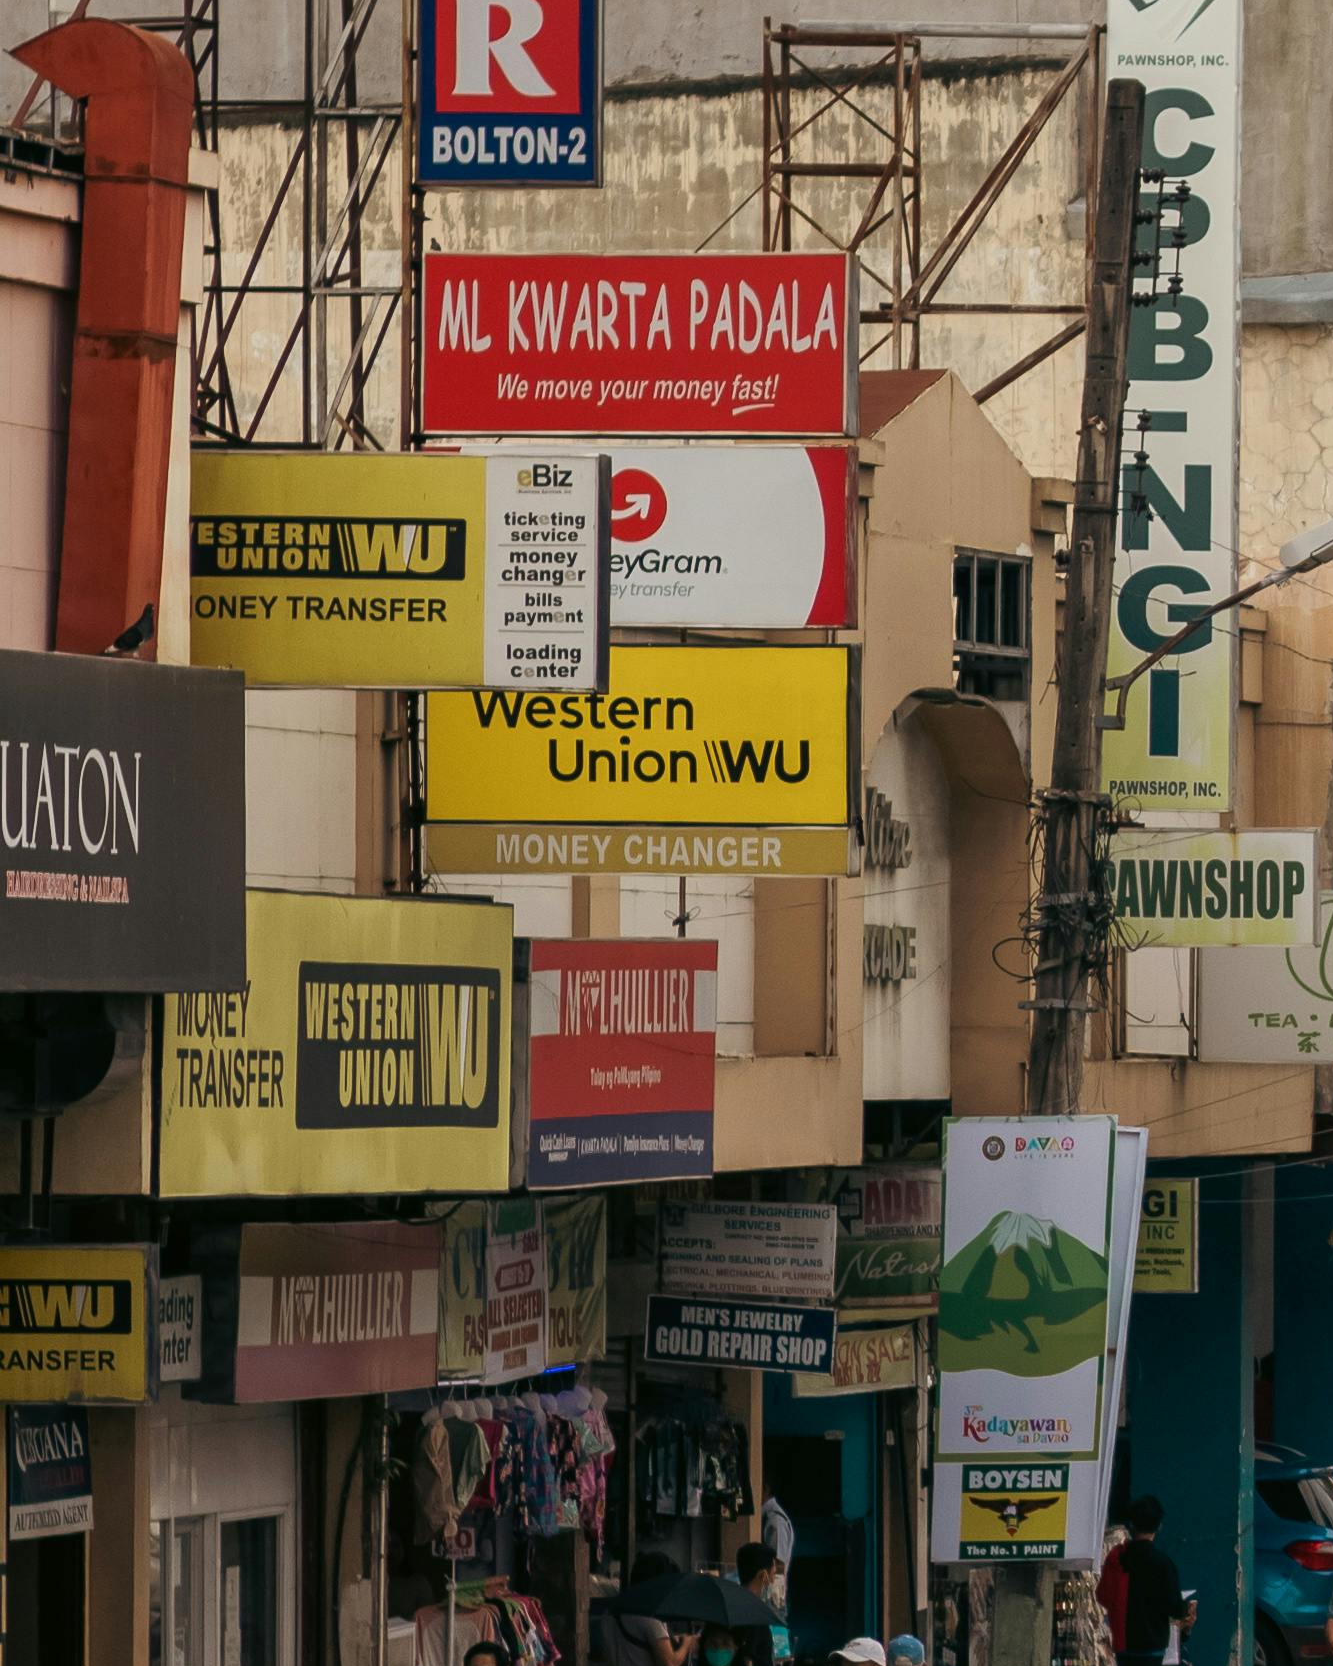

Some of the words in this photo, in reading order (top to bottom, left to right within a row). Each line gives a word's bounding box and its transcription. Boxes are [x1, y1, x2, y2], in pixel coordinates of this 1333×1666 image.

[1117, 55, 1196, 68] PAWNSHOP,
[1201, 55, 1229, 66] INC.
[432, 126, 587, 165] BOLTON-2
[438, 279, 491, 352] ML
[508, 279, 671, 354] KWARTA
[689, 278, 838, 354] PADALA
[497, 374, 528, 400] We
[535, 380, 592, 400] move
[597, 379, 649, 405] your
[652, 379, 726, 406] money
[731, 374, 780, 401] fast!
[517, 464, 573, 488] eBiz
[191, 522, 331, 546] ESTERN
[504, 511, 586, 530] ticketing
[351, 524, 447, 573] WU
[510, 529, 578, 543] service
[216, 548, 331, 572] UNION
[509, 551, 577, 567] money
[609, 549, 722, 578] eyGram
[501, 566, 586, 586] changer
[524, 593, 563, 607] bills
[630, 583, 695, 598] transfer
[192, 595, 277, 619] ONEY
[286, 596, 447, 622] TRANSFER
[504, 609, 583, 626] payment
[506, 644, 582, 663] loading
[510, 663, 578, 678] center
[472, 692, 693, 731] Western
[549, 736, 698, 782] Union
[1109, 780, 1189, 798] PAWNSHOP,
[1193, 782, 1221, 797] INC.
[496, 834, 608, 865] MONEY
[624, 834, 781, 867] CHANGER
[176, 981, 251, 1038] MONEY
[305, 982, 415, 1041] WESTERN
[600, 968, 689, 1035] LHUILLIER
[1248, 1013, 1298, 1028] TEA
[427, 984, 490, 1109] WU
[176, 1048, 284, 1109] TRANSFER
[339, 1049, 415, 1106] UNION
[1015, 1136, 1075, 1151] DAVAO
[1142, 1190, 1178, 1217] GI
[724, 1219, 781, 1231] SERVICES
[1146, 1225, 1175, 1239] INC
[28, 1285, 115, 1329] WU
[160, 1290, 193, 1330] ading
[681, 1305, 730, 1327] MEN'S
[733, 1309, 804, 1332] JEWELRY
[162, 1337, 192, 1364] nter
[655, 1325, 703, 1356] GOLD
[706, 1330, 773, 1362] REPAIR
[775, 1336, 827, 1367] SHOP
[962, 1416, 1072, 1443] Kadayawan
[969, 1469, 1062, 1489] BOYSEN
[966, 1545, 987, 1556] The
[1024, 1544, 1058, 1556] PAINT
